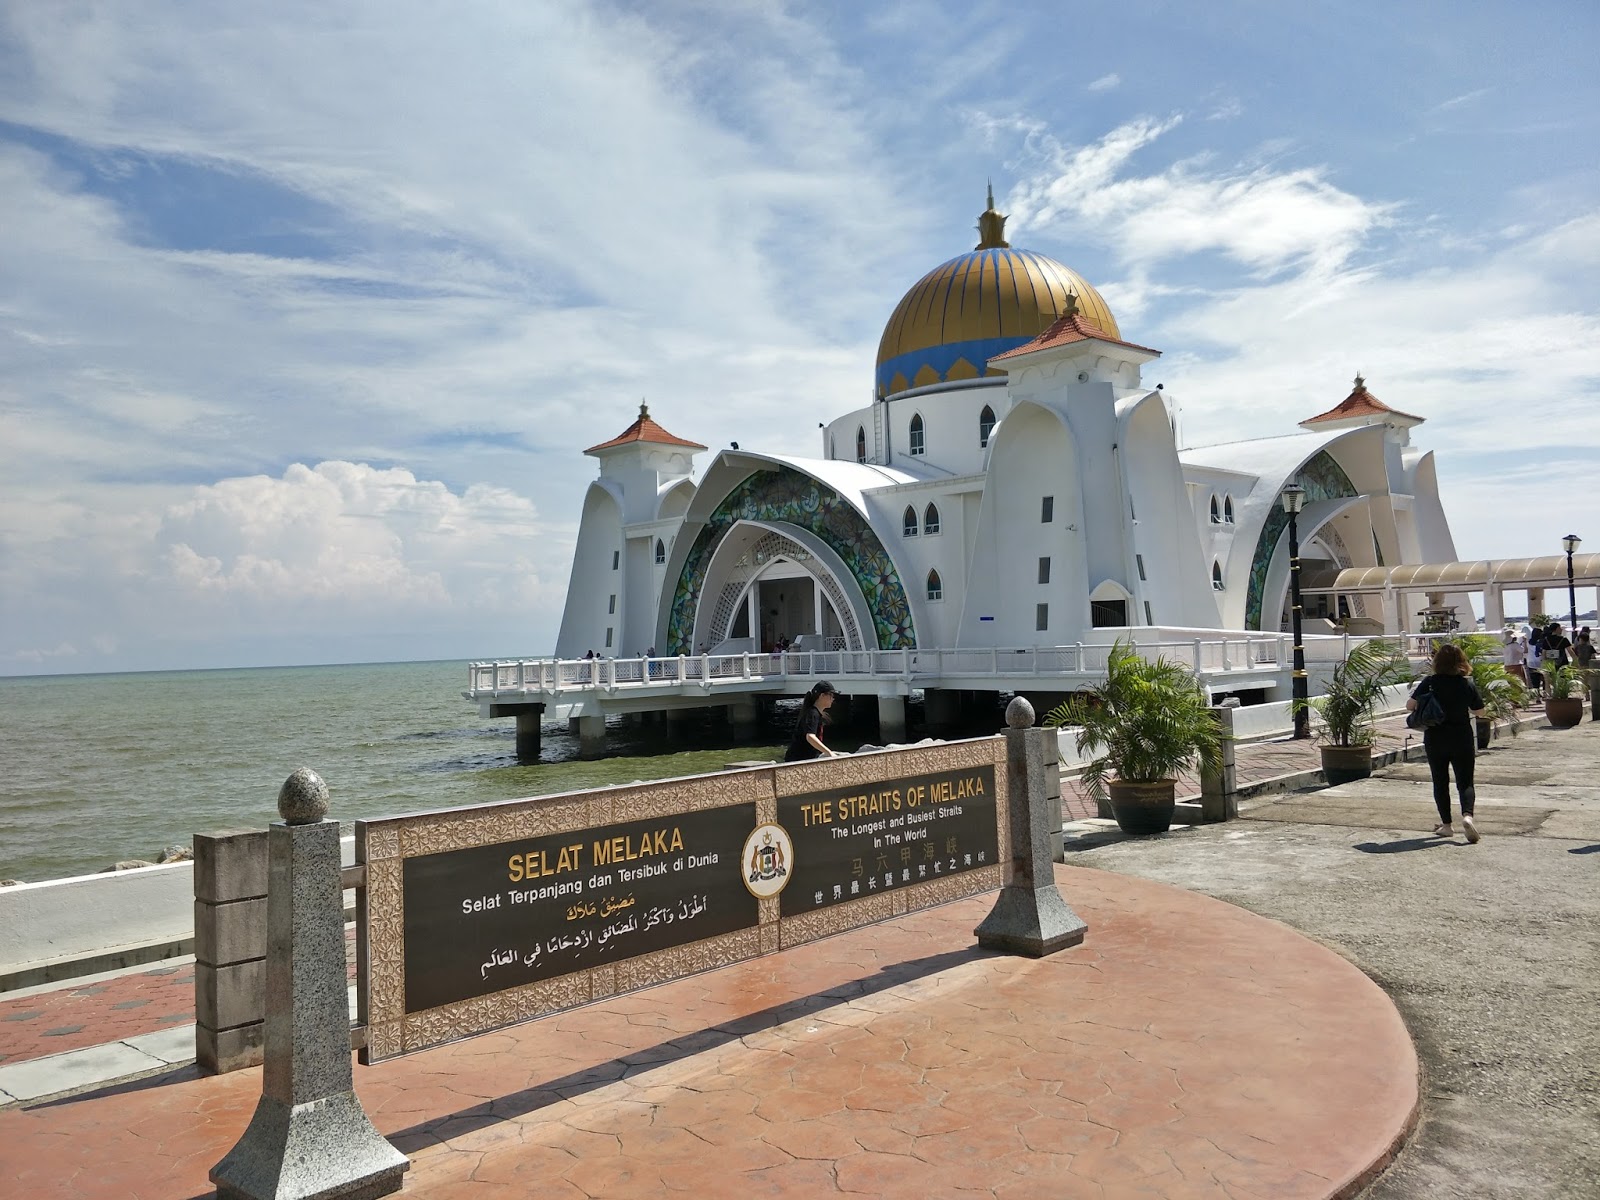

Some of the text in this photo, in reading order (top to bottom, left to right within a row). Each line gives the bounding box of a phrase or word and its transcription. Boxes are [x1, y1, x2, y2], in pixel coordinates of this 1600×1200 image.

[800, 776, 985, 827] THE STRAITS OF MELAKA
[831, 804, 963, 840] The Longest and Busiest Straits
[508, 827, 684, 882] SELAT MELAKA
[873, 827, 927, 848] In The World
[462, 851, 719, 915] Selat Terpanjang dan Tersibuk di Dunia
